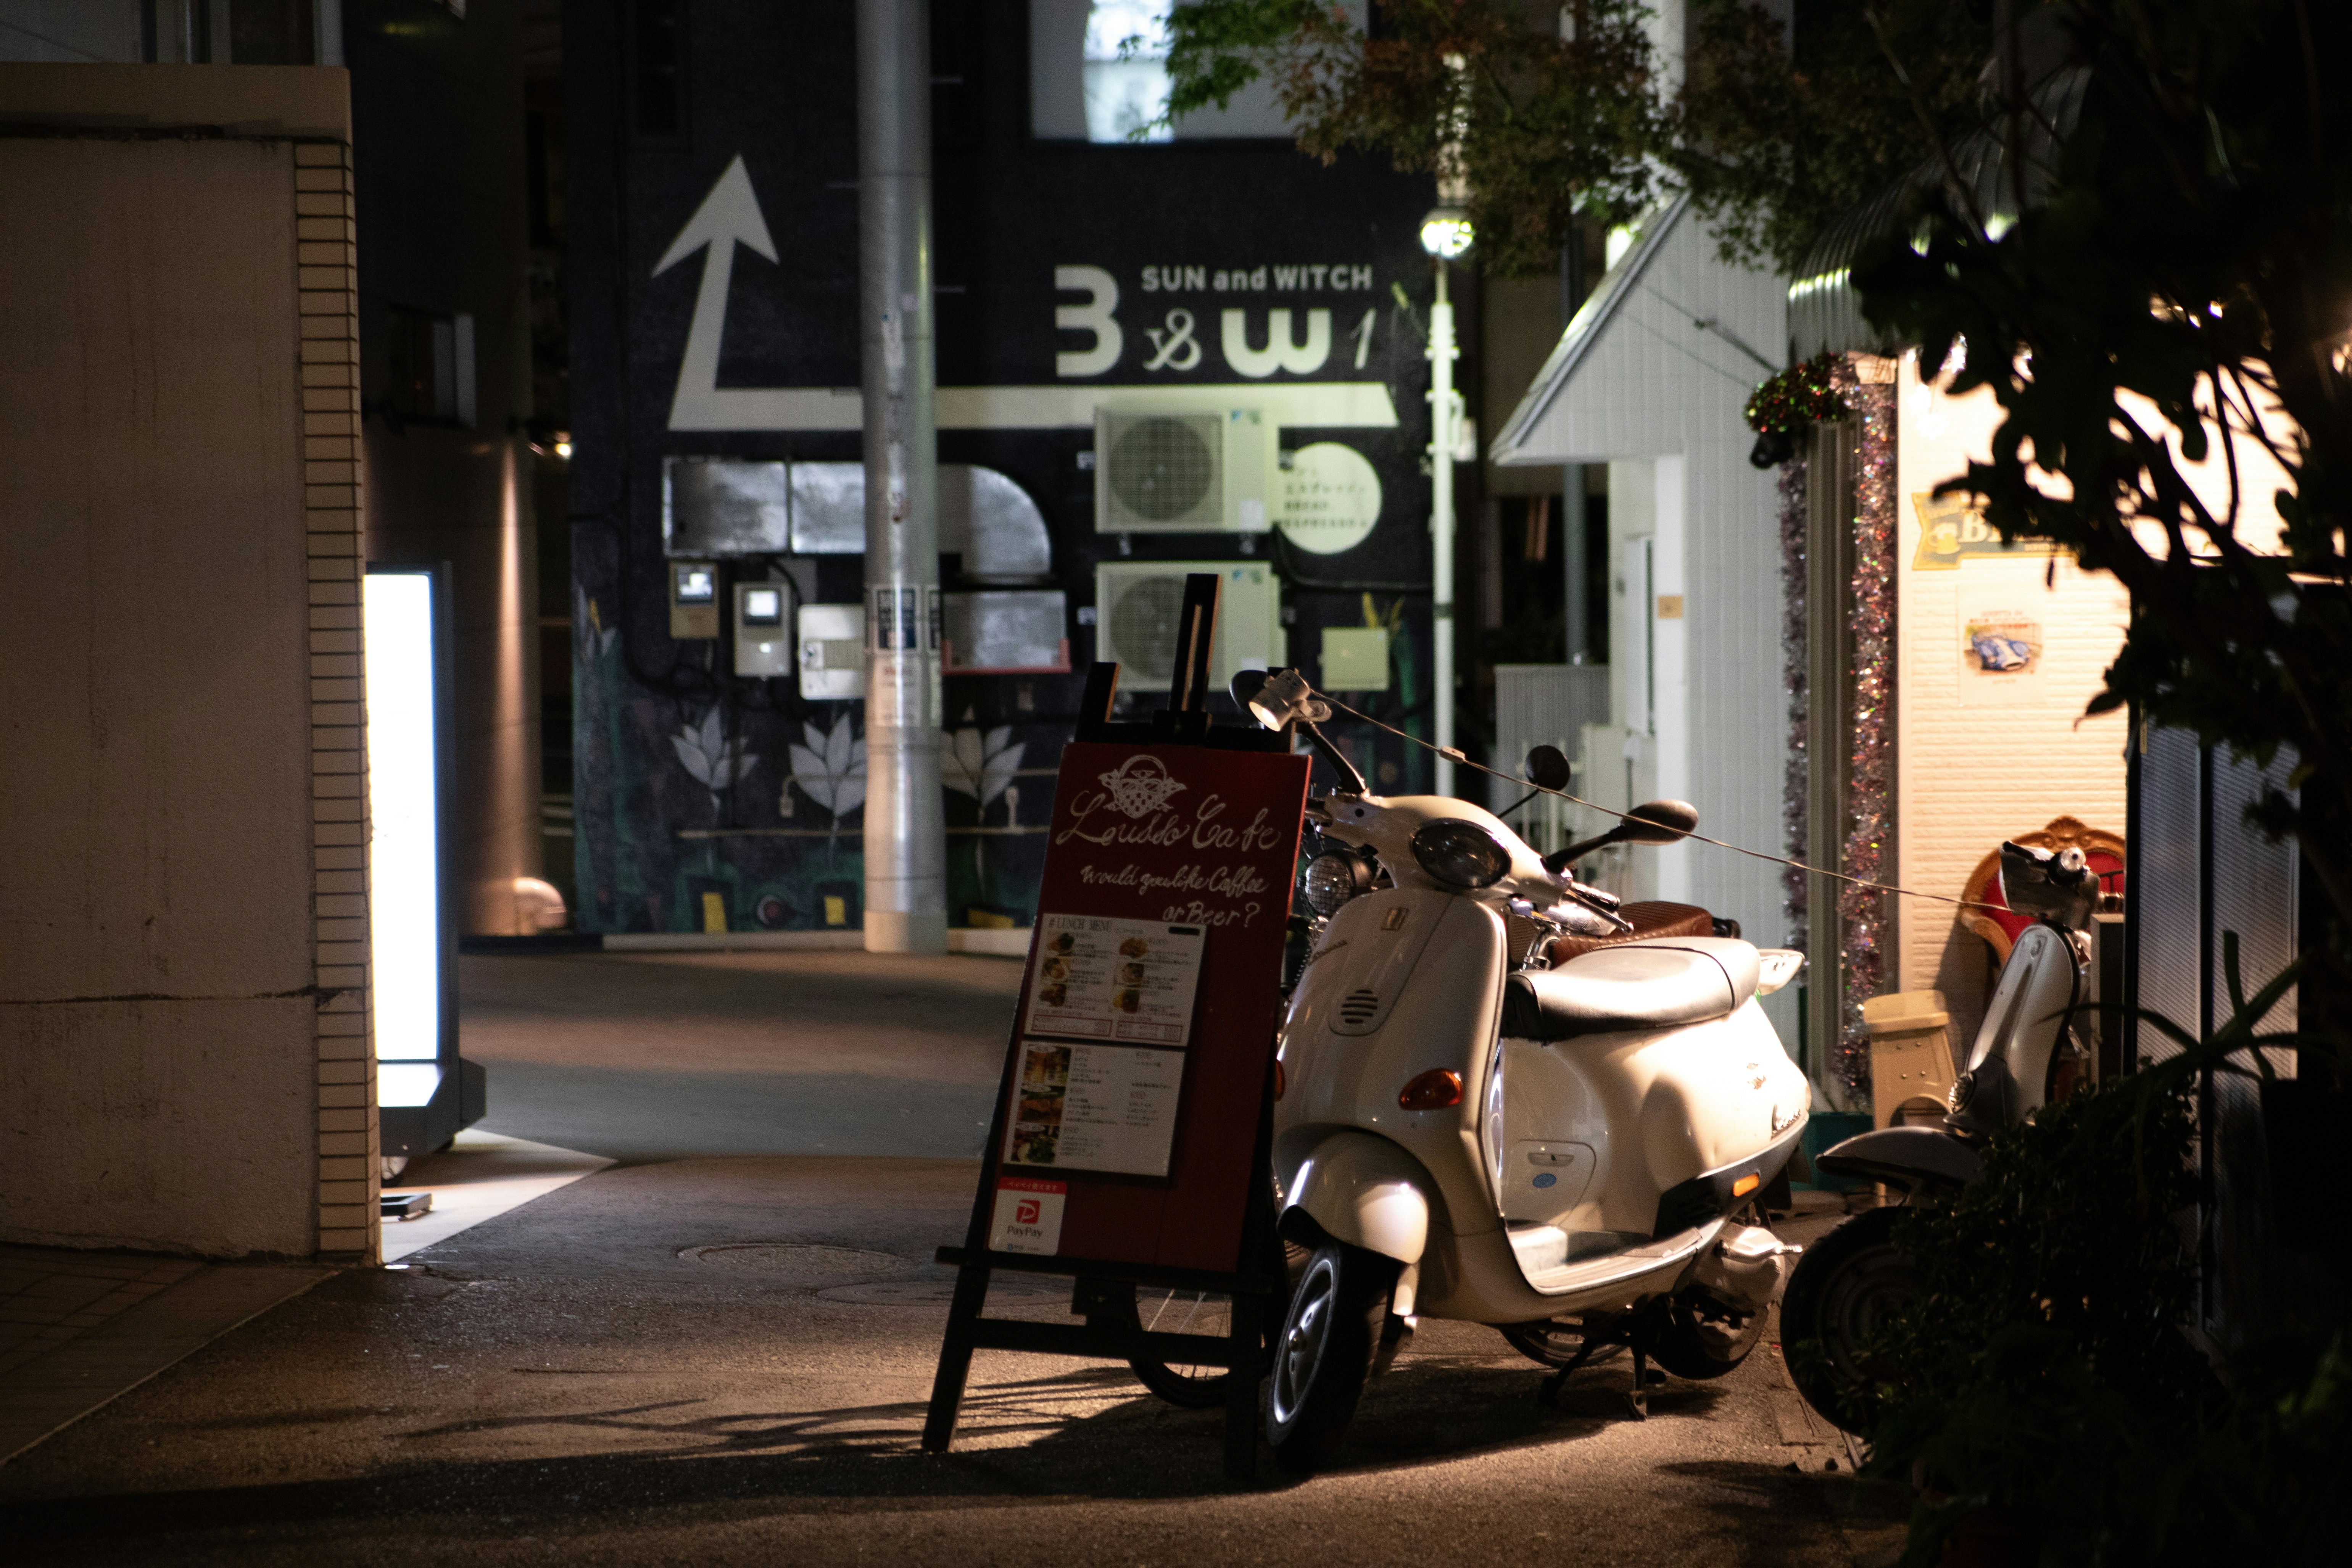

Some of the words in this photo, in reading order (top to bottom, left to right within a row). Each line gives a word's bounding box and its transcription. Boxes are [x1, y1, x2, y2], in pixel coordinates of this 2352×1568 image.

[1142, 266, 1206, 291] SUN
[1213, 266, 1267, 291] and
[1274, 265, 1373, 290] WITCH
[1192, 794, 1281, 852] Cafe
[1208, 865, 1270, 898] Coffee
[1007, 1225, 1043, 1239] PayPay
